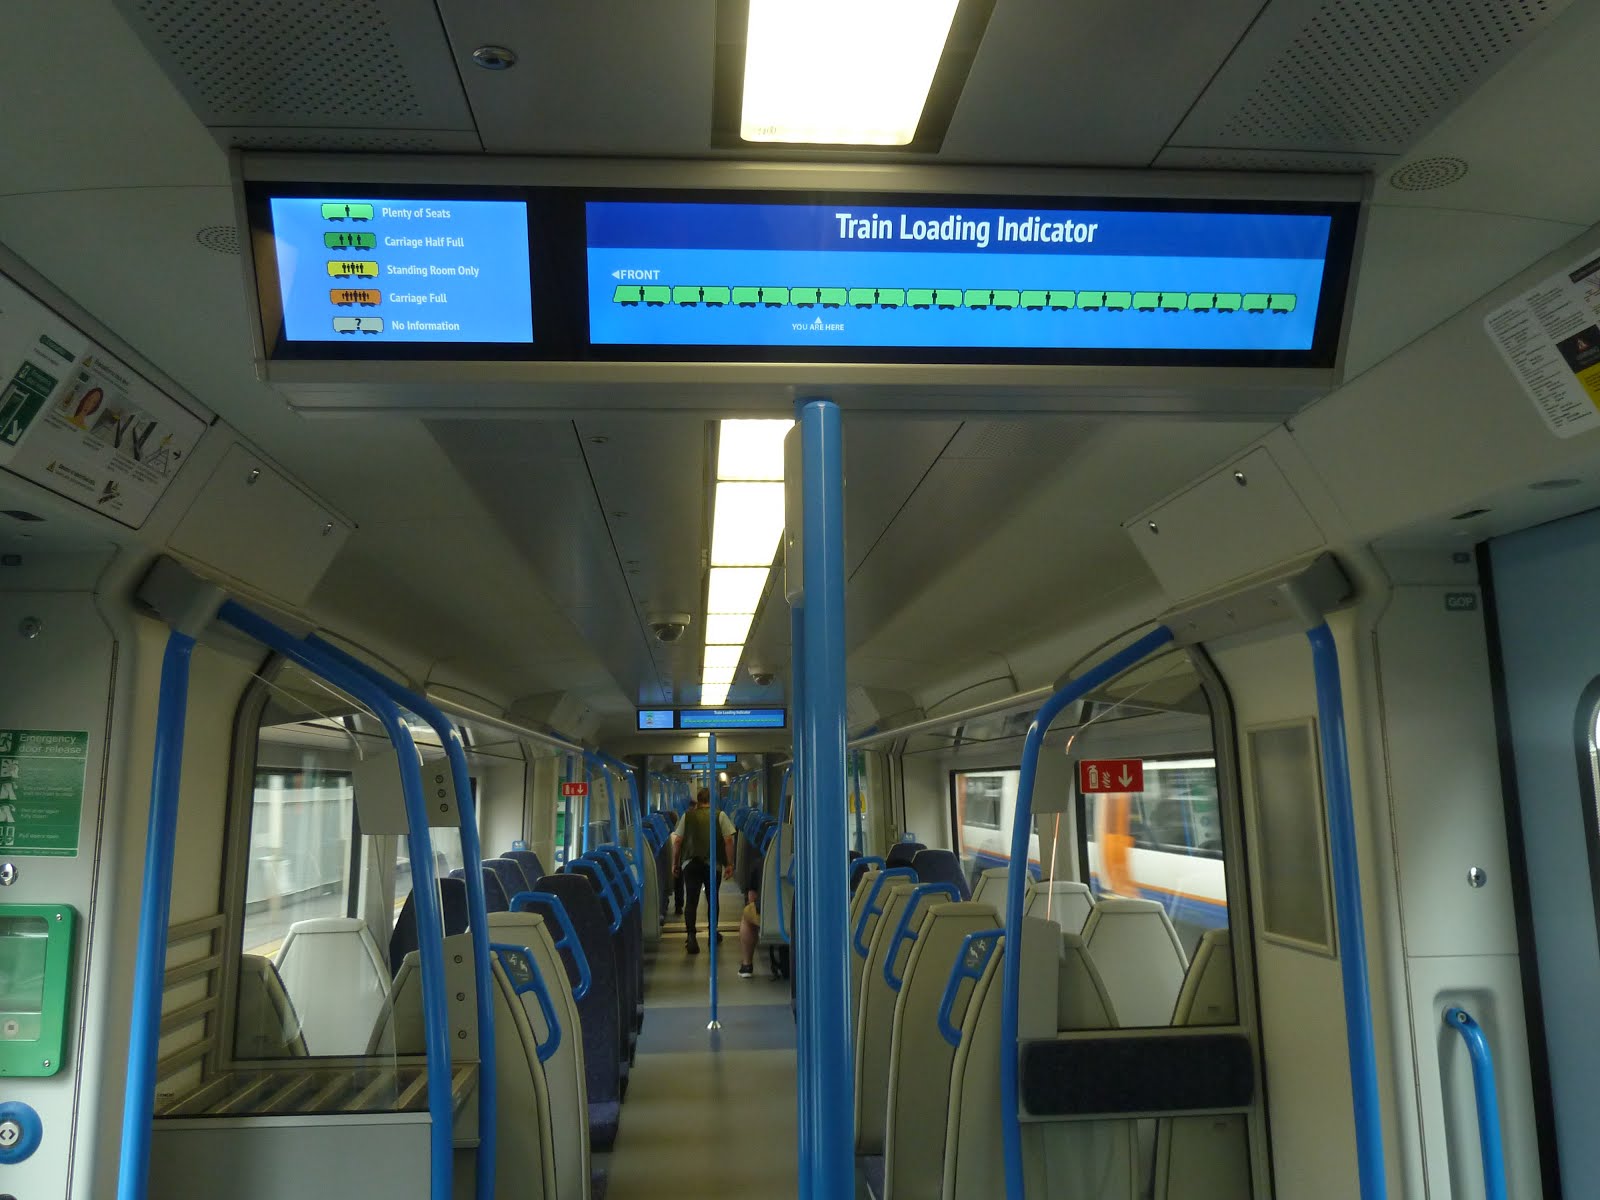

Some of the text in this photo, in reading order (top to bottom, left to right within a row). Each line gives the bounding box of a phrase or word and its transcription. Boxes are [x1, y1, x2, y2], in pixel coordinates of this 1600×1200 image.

[382, 208, 451, 220] Plenty of Seats
[835, 213, 1098, 248] Train Loading Indicator
[384, 237, 465, 249] Carriage Half Full
[387, 265, 480, 278] Standing Room Only
[620, 269, 661, 280] FRONT
[390, 293, 448, 304] Carriage Full
[391, 320, 460, 331] No Information
[791, 323, 845, 331] YOU ARE HERE
[20, 733, 77, 744] Emergency
[18, 745, 82, 754] door release
